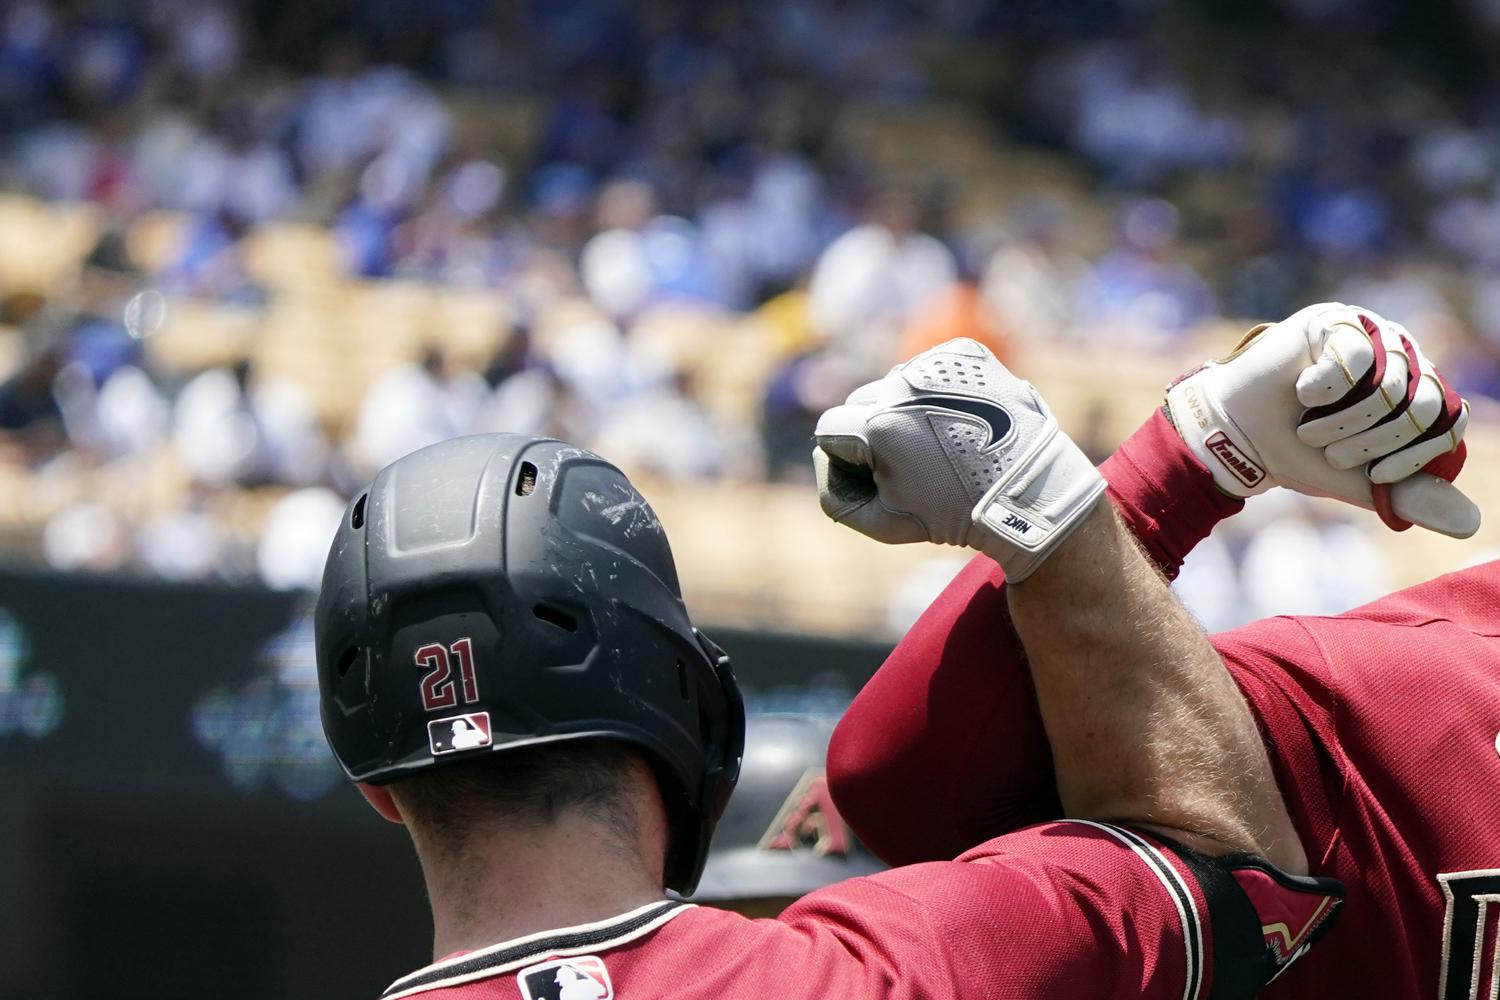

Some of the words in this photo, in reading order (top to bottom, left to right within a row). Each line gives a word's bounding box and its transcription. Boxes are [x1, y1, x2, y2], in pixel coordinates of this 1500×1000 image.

[1208, 438, 1260, 483] Franklin
[1001, 512, 1033, 535] NIKE
[414, 637, 480, 711] 21
